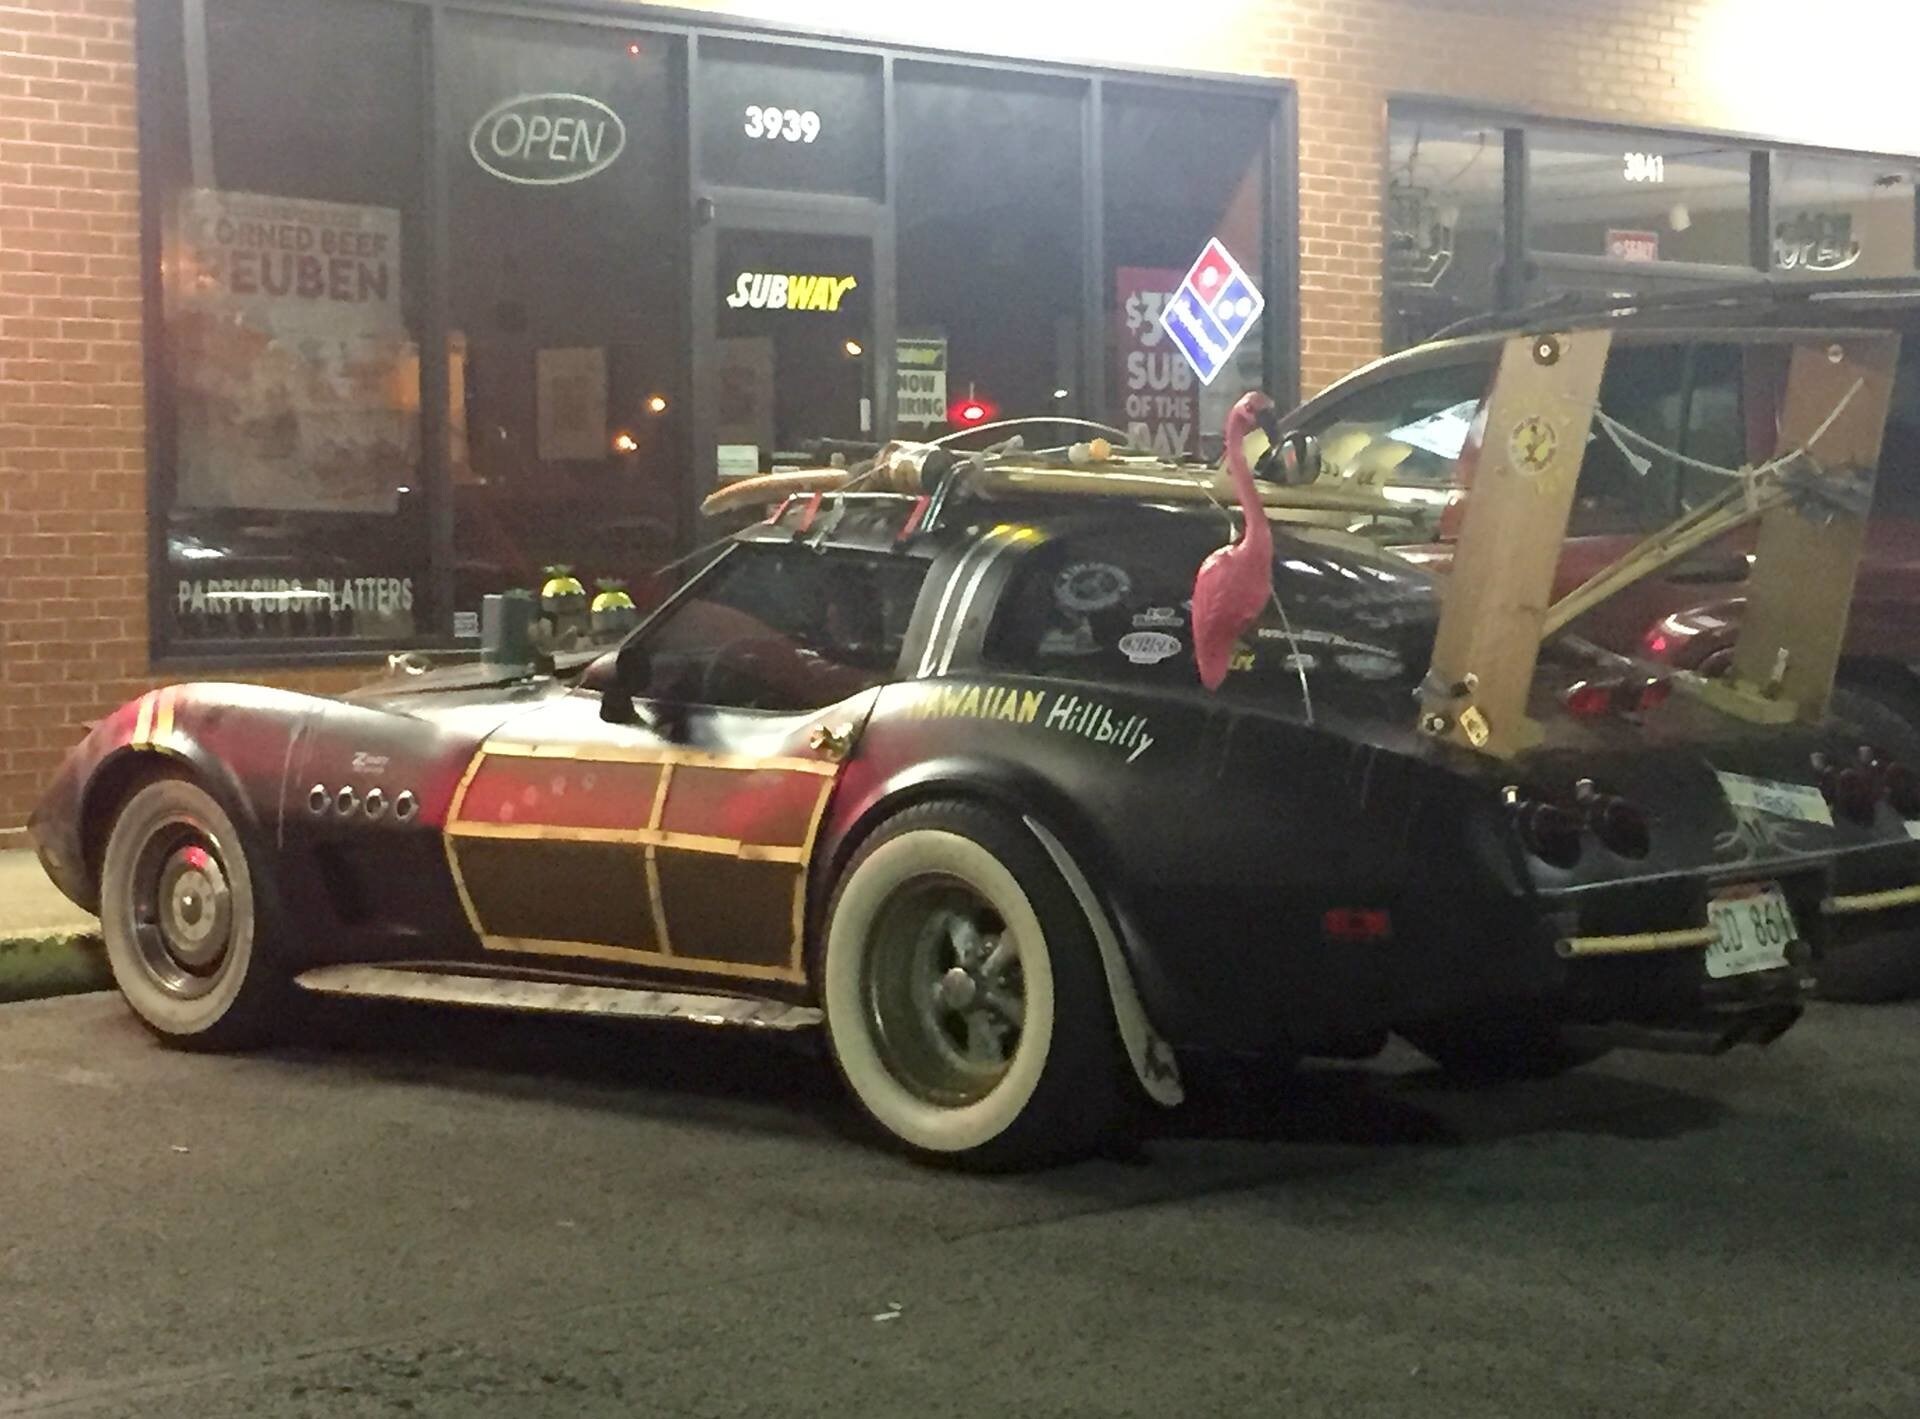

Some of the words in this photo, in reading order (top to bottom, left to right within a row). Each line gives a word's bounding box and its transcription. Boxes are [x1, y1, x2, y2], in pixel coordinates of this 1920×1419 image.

[491, 113, 605, 162] OPEN
[745, 105, 820, 143] 3939
[321, 228, 387, 257] BEEF
[727, 272, 857, 311] SUBWAY
[897, 374, 935, 393] NOW
[1127, 351, 1192, 390] SUB
[1126, 395, 1151, 418] OF
[1154, 396, 1191, 419] THE
[1127, 421, 1192, 456] DAY
[251, 578, 301, 613] SUBS
[316, 577, 413, 614] PLATTERS
[1044, 693, 1154, 764] Hillbilly
